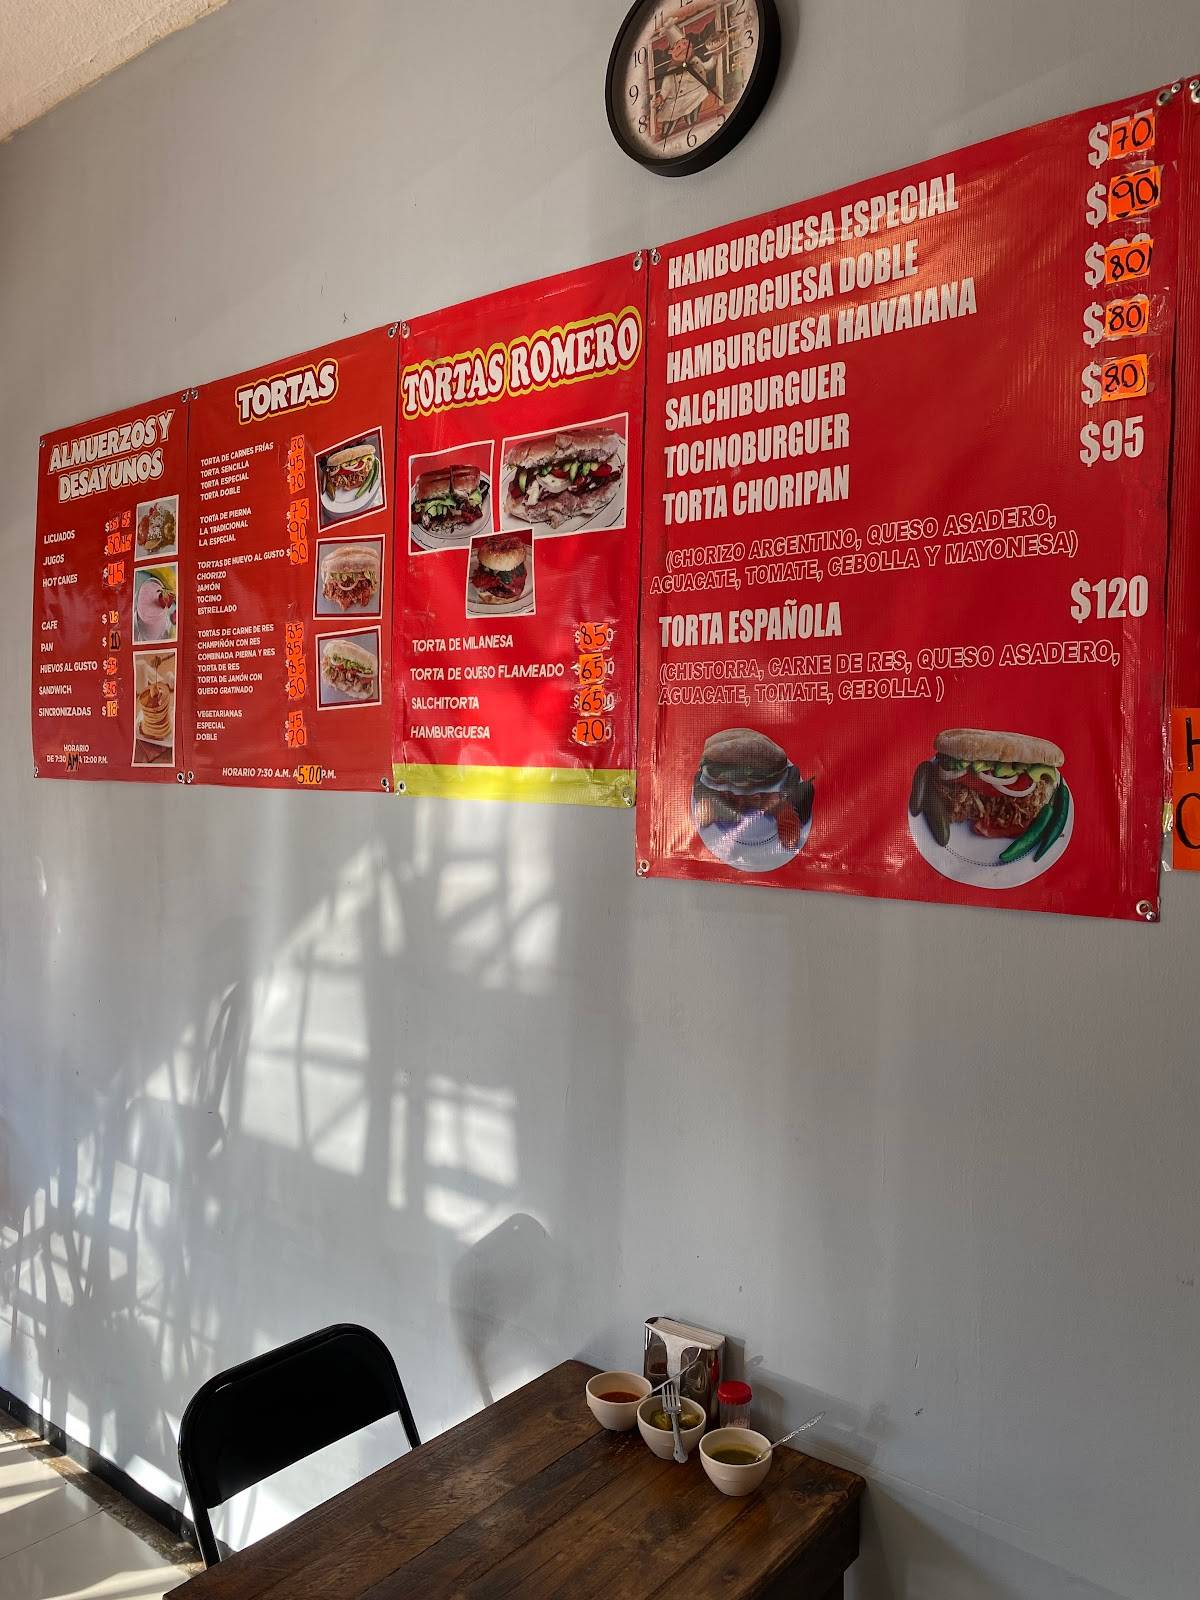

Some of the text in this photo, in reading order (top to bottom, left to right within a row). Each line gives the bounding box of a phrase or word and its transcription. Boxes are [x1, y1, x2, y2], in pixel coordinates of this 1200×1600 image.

[744, 30, 754, 49] 3
[633, 47, 647, 68] 10
[629, 85, 639, 105] 9
[638, 115, 648, 134] 8
[686, 127, 697, 147] 6
[669, 173, 959, 289] HAMBURGUESA ESPECIAL
[668, 239, 919, 337] HAMBURGUESA DOBLE
[667, 277, 977, 384] HAMBURGUESA HAWAIANA
[402, 310, 640, 416] TORTAS ROMERO
[236, 360, 337, 422] TORTAS
[665, 362, 847, 431] SALCHIBURGUER
[48, 409, 175, 474] ALMUERZOS Y
[664, 412, 850, 478] TOCINOBURGUER
[1079, 415, 1144, 467] $95
[201, 442, 274, 467] TORTA DE CARNES FRÍAS
[59, 448, 163, 502] DESAYUNOS
[201, 460, 249, 478] TORTA SENCILLA
[201, 472, 249, 489] TORTA ESPECIAL
[200, 486, 240, 501] TORTA DOBLE
[663, 464, 850, 525] TORTA CHORIPAN
[200, 507, 252, 524] TORTA DE PIERNA
[210, 520, 248, 533] TRADICIONAL
[44, 530, 75, 544] LICUADOS
[209, 534, 236, 546] ESPECIAL
[665, 503, 1057, 572] (CHORIZO ARGENTINO, QUESO ASADERO,
[43, 554, 64, 565] JUGOS
[198, 560, 223, 569] TORTAS
[224, 558, 231, 566] DE
[263, 549, 284, 559] GUSTO
[650, 530, 1079, 594] AGUACATE, TOMATE, CEBOLLA Y MAYONESA)
[43, 577, 57, 588] HOT
[197, 571, 226, 580] CHORIZO
[197, 594, 222, 603] TOCINO
[198, 604, 237, 615] ESTRELLADO
[659, 575, 1149, 648] TORTA ESPAÑOLA $120
[41, 620, 58, 630] CAFE
[198, 624, 274, 638] TORTAS DE CARNE DE RES
[40, 642, 54, 652] PAN
[249, 637, 261, 645] RES
[412, 635, 514, 653] TORTA DE MILANESA
[263, 648, 276, 656] RES
[64, 663, 73, 672] AL
[74, 661, 98, 671] GUSTO
[197, 664, 217, 672] TORTA
[659, 639, 1121, 683] (CHISTORRA, CARNE DE RES, QUESO ASADERO,
[197, 675, 218, 684] TORTA
[410, 663, 565, 681] TORTA DE QUESO FLAMEADO
[39, 685, 72, 695] SANDWICH
[197, 687, 218, 695] QUESO
[658, 686, 751, 707] AGUACATE,
[754, 682, 833, 704] TOMATE,
[838, 677, 930, 700] CEBOLLA
[38, 707, 91, 716] SINCRONIZADAS
[411, 697, 480, 710] SALCHITORTA
[411, 725, 490, 739] HAMBURGUESA
[63, 744, 90, 752] HORARIO
[222, 767, 255, 777] HORARIO
[257, 768, 273, 777] 7:30
